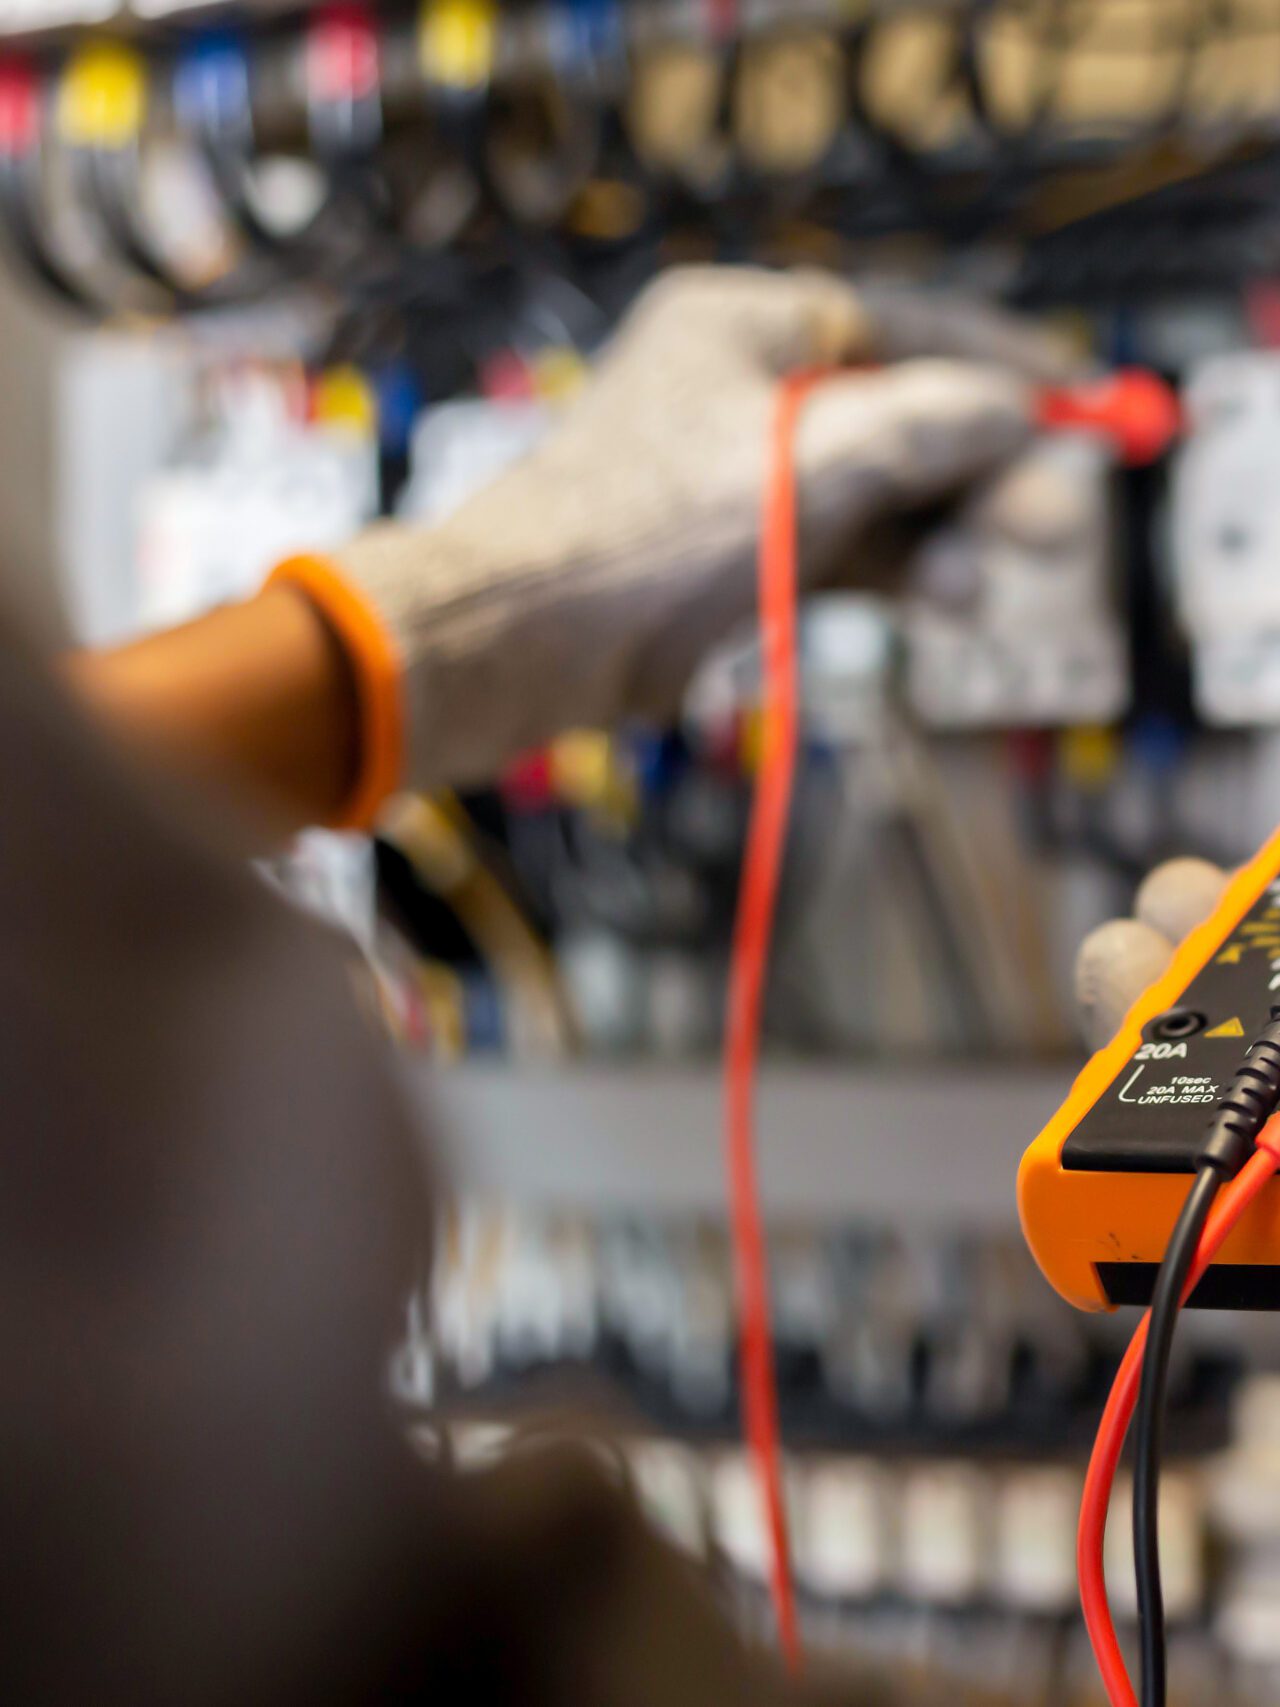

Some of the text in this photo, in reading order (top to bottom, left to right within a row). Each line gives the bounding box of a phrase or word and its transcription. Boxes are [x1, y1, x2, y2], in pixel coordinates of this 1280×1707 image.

[1133, 1042, 1188, 1060] 20A
[1170, 1075, 1212, 1085] 10sec
[1146, 1084, 1219, 1095] 20A MAX
[1137, 1094, 1214, 1105] UNFUSED
